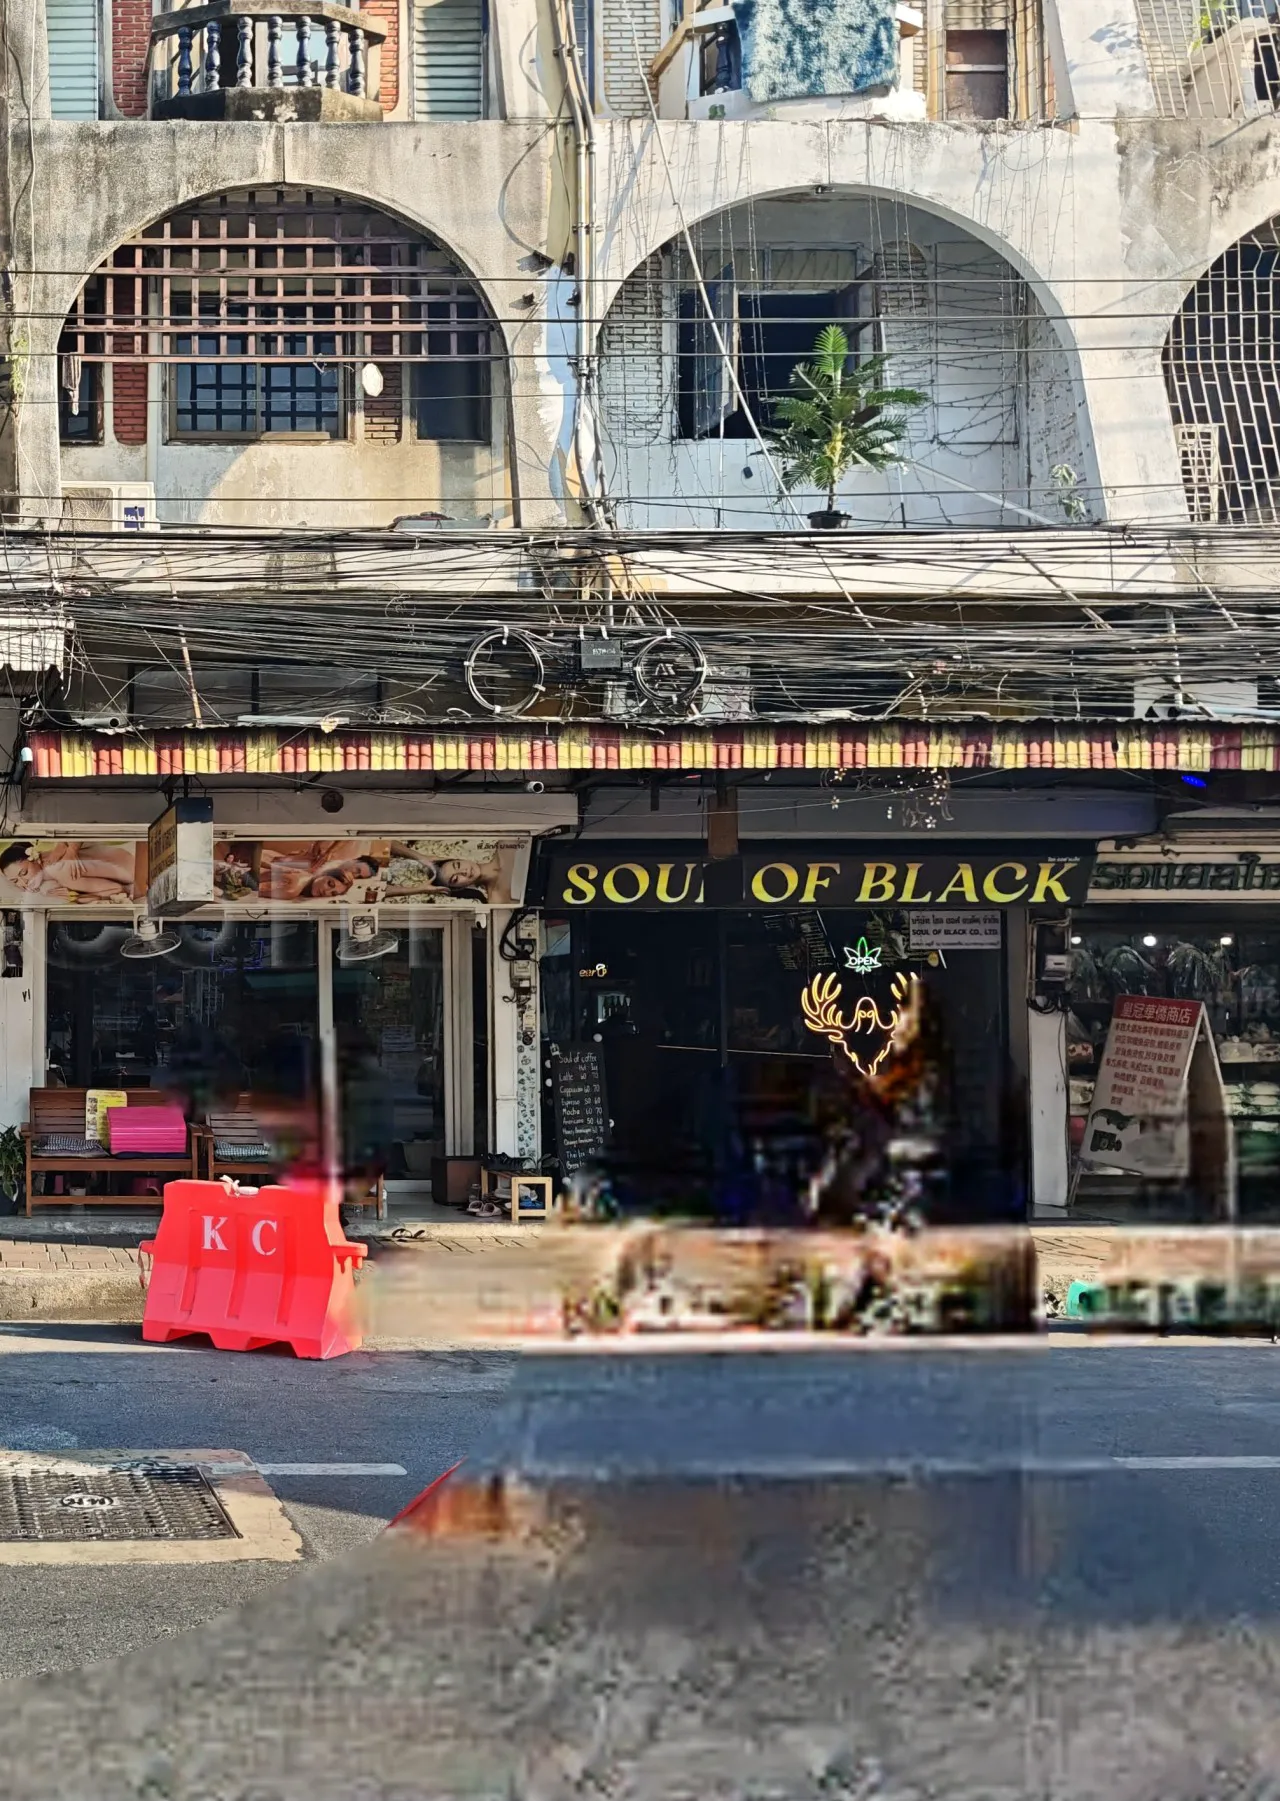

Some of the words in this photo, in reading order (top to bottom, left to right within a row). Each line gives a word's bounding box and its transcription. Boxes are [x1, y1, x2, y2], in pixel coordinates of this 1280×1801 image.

[562, 862, 705, 905] SOU
[751, 862, 841, 904] OF
[855, 862, 1079, 904] BLACK
[850, 956, 877, 966] OPEN
[201, 1215, 229, 1251] K
[252, 1219, 277, 1256] C
